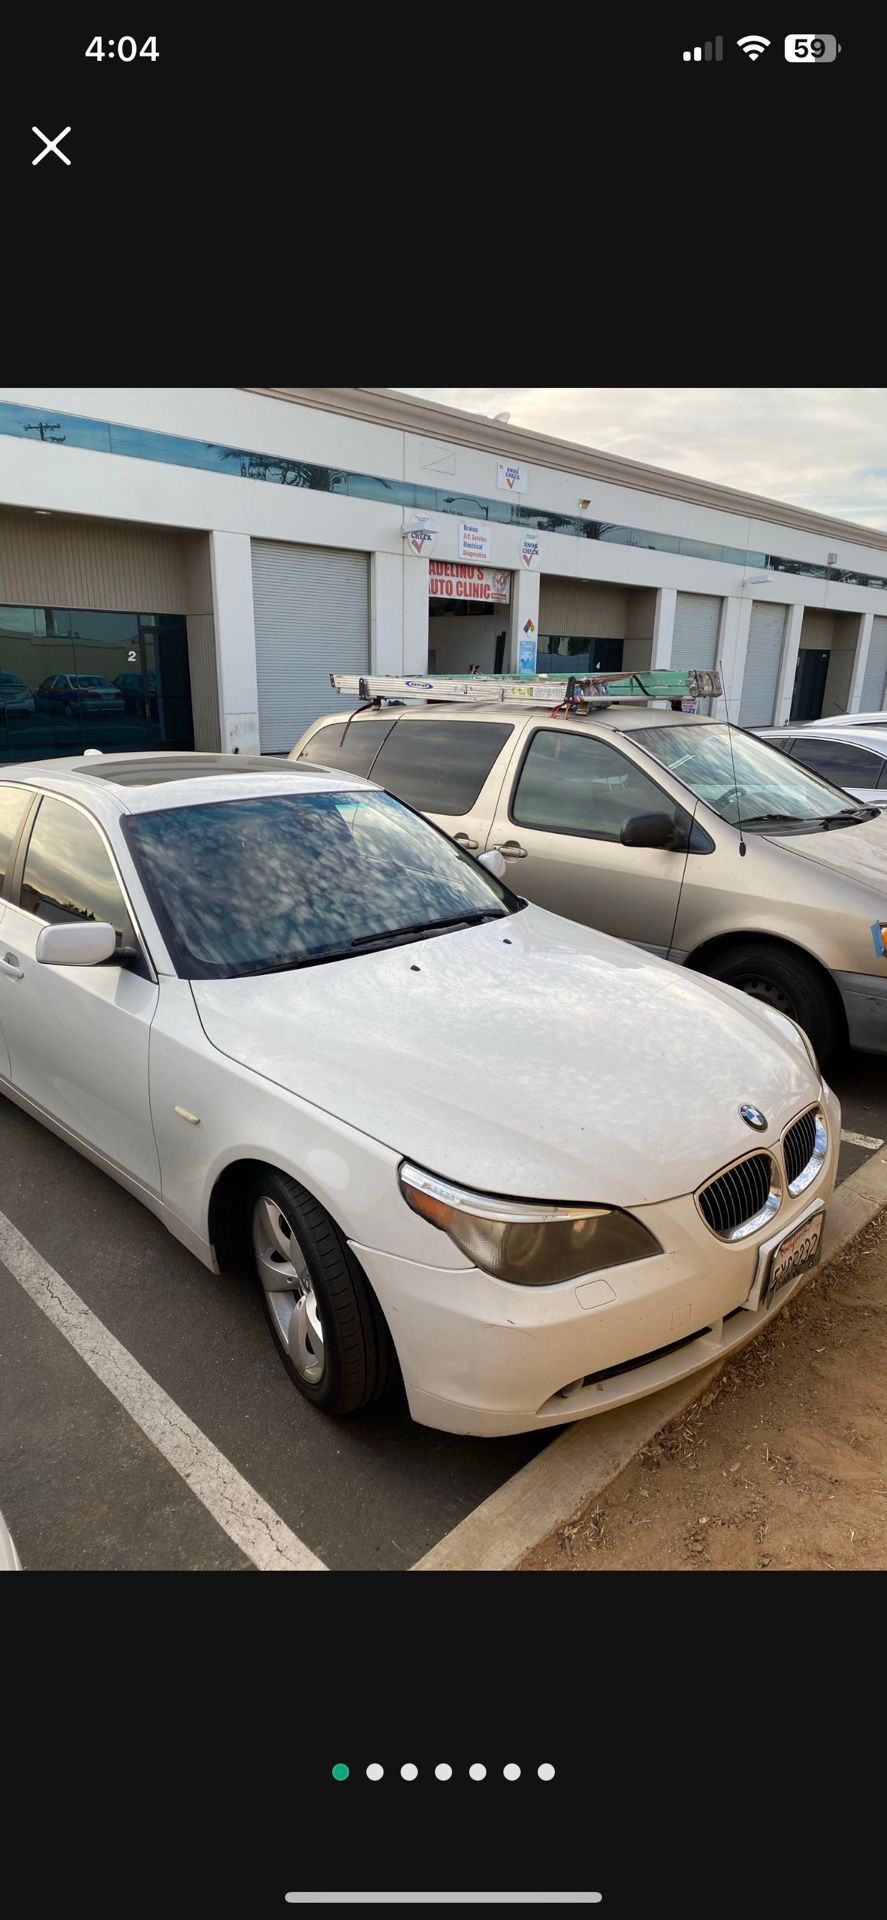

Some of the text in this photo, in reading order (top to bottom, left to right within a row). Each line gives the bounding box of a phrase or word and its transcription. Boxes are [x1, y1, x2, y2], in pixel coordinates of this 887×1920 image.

[411, 532, 432, 541] CHECK
[522, 547, 539, 555] CHECK
[429, 578, 491, 599] UTO CLINIC
[127, 650, 137, 662] 2
